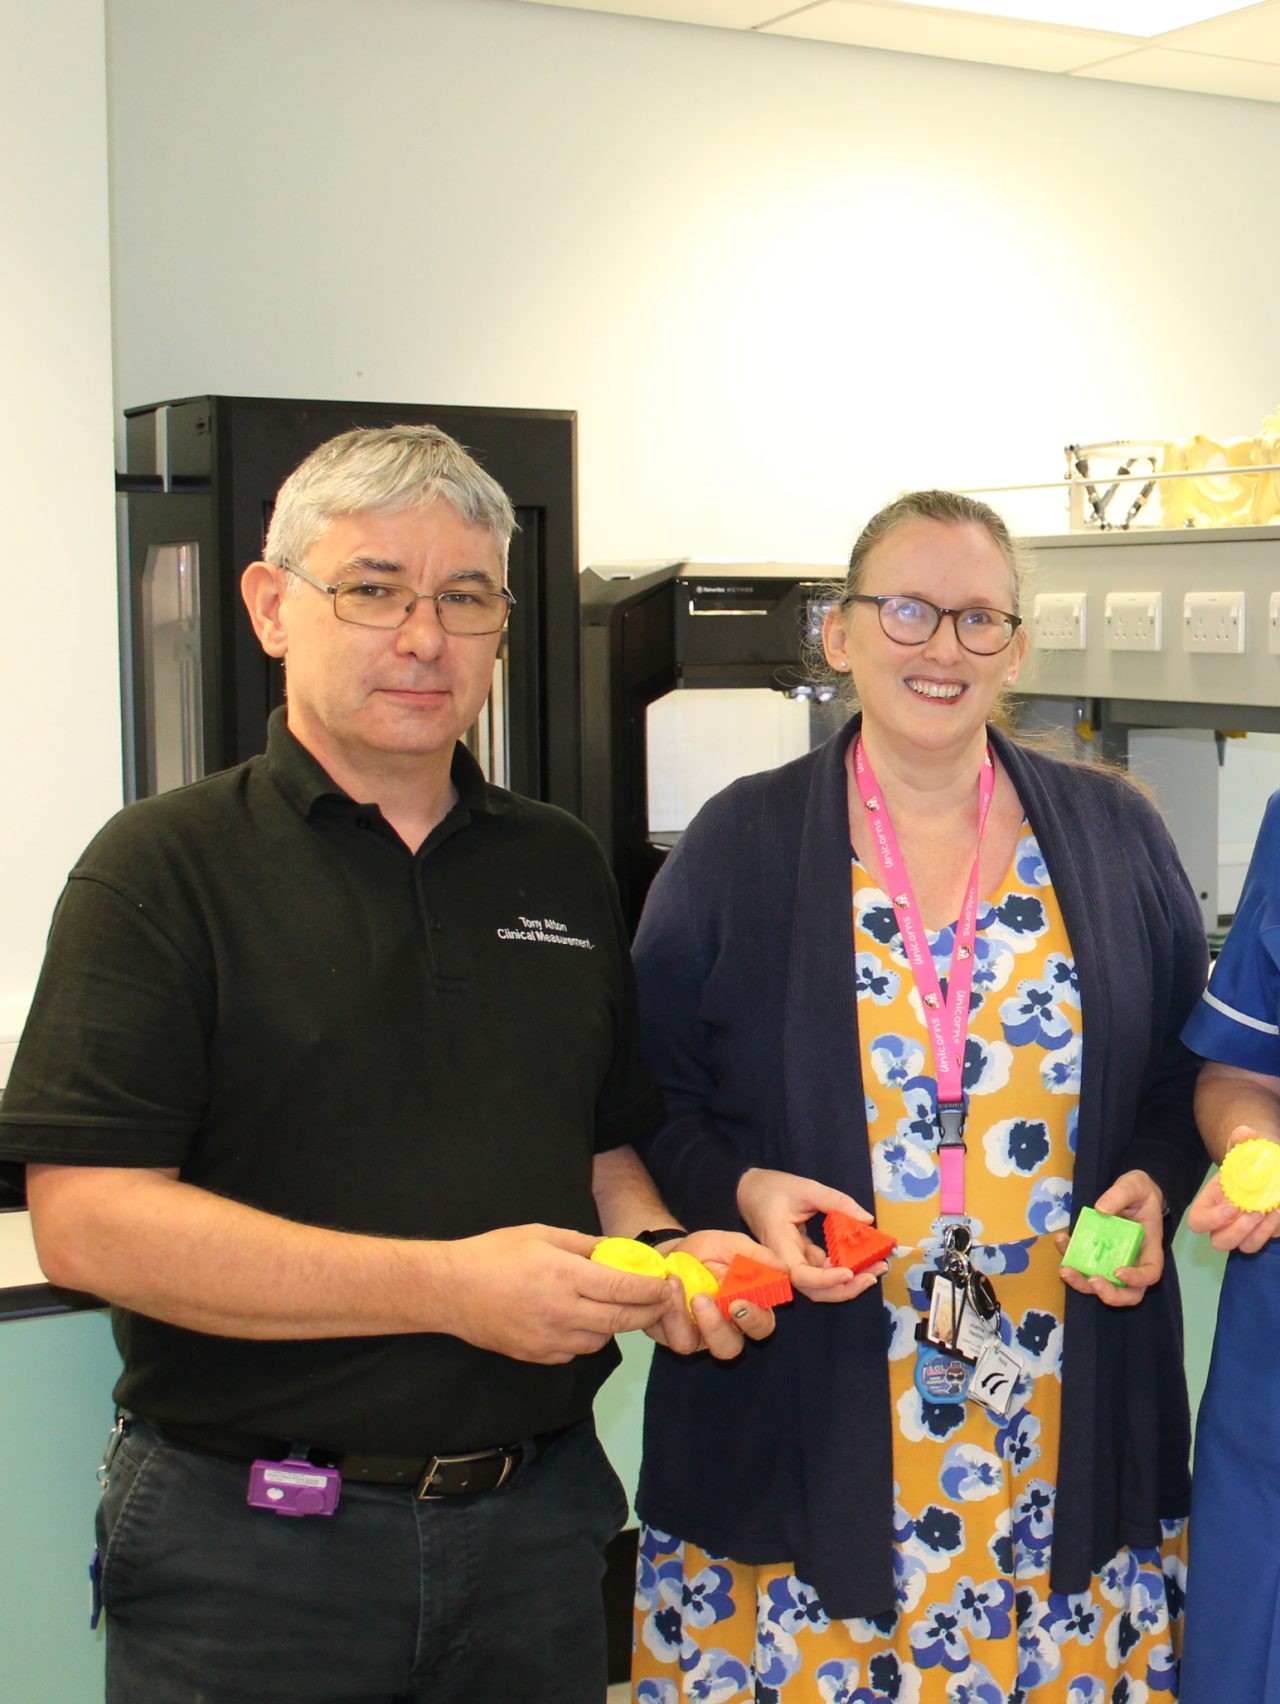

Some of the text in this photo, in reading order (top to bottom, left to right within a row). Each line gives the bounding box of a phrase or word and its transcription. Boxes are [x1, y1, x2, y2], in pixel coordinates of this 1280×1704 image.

[873, 819, 894, 868] Unicorns
[518, 916, 543, 931] Tony
[963, 887, 976, 937] Unicorns
[497, 928, 592, 950] Clinical Measurement
[903, 916, 924, 966] Unicorns
[931, 1017, 950, 1073] Unicorns
